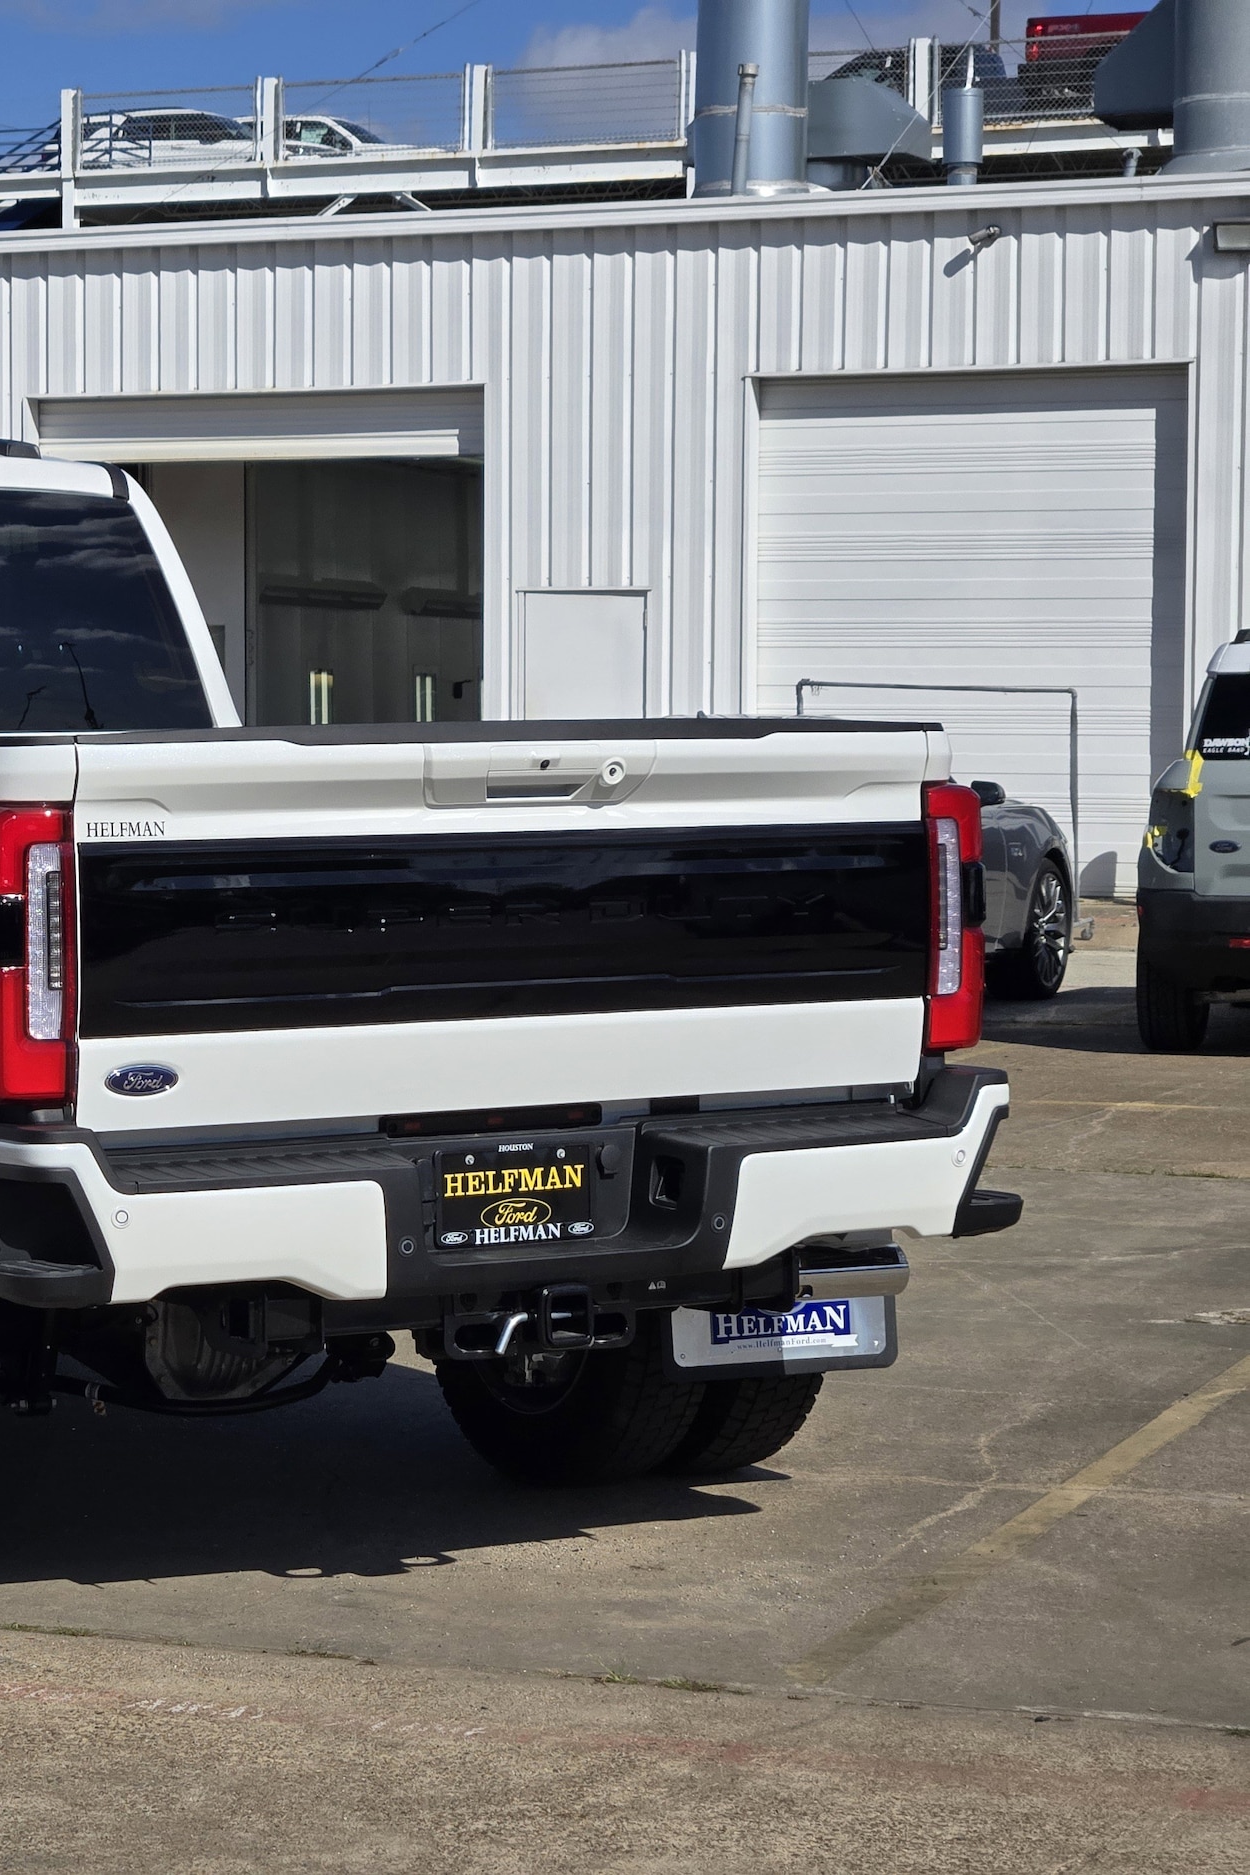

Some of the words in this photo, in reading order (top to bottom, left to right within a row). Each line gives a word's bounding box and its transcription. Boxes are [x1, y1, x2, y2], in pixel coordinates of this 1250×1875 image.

[86, 821, 165, 837] HELFMAN
[123, 1071, 163, 1090] Ford
[498, 1143, 534, 1152] HOUSTON
[444, 1164, 584, 1197] HELFMAN
[494, 1202, 538, 1226] Ford
[445, 1233, 464, 1241] Ford
[474, 1222, 563, 1245] HELFMAN
[572, 1222, 590, 1233] Ford
[715, 1304, 847, 1339] HELFMAN
